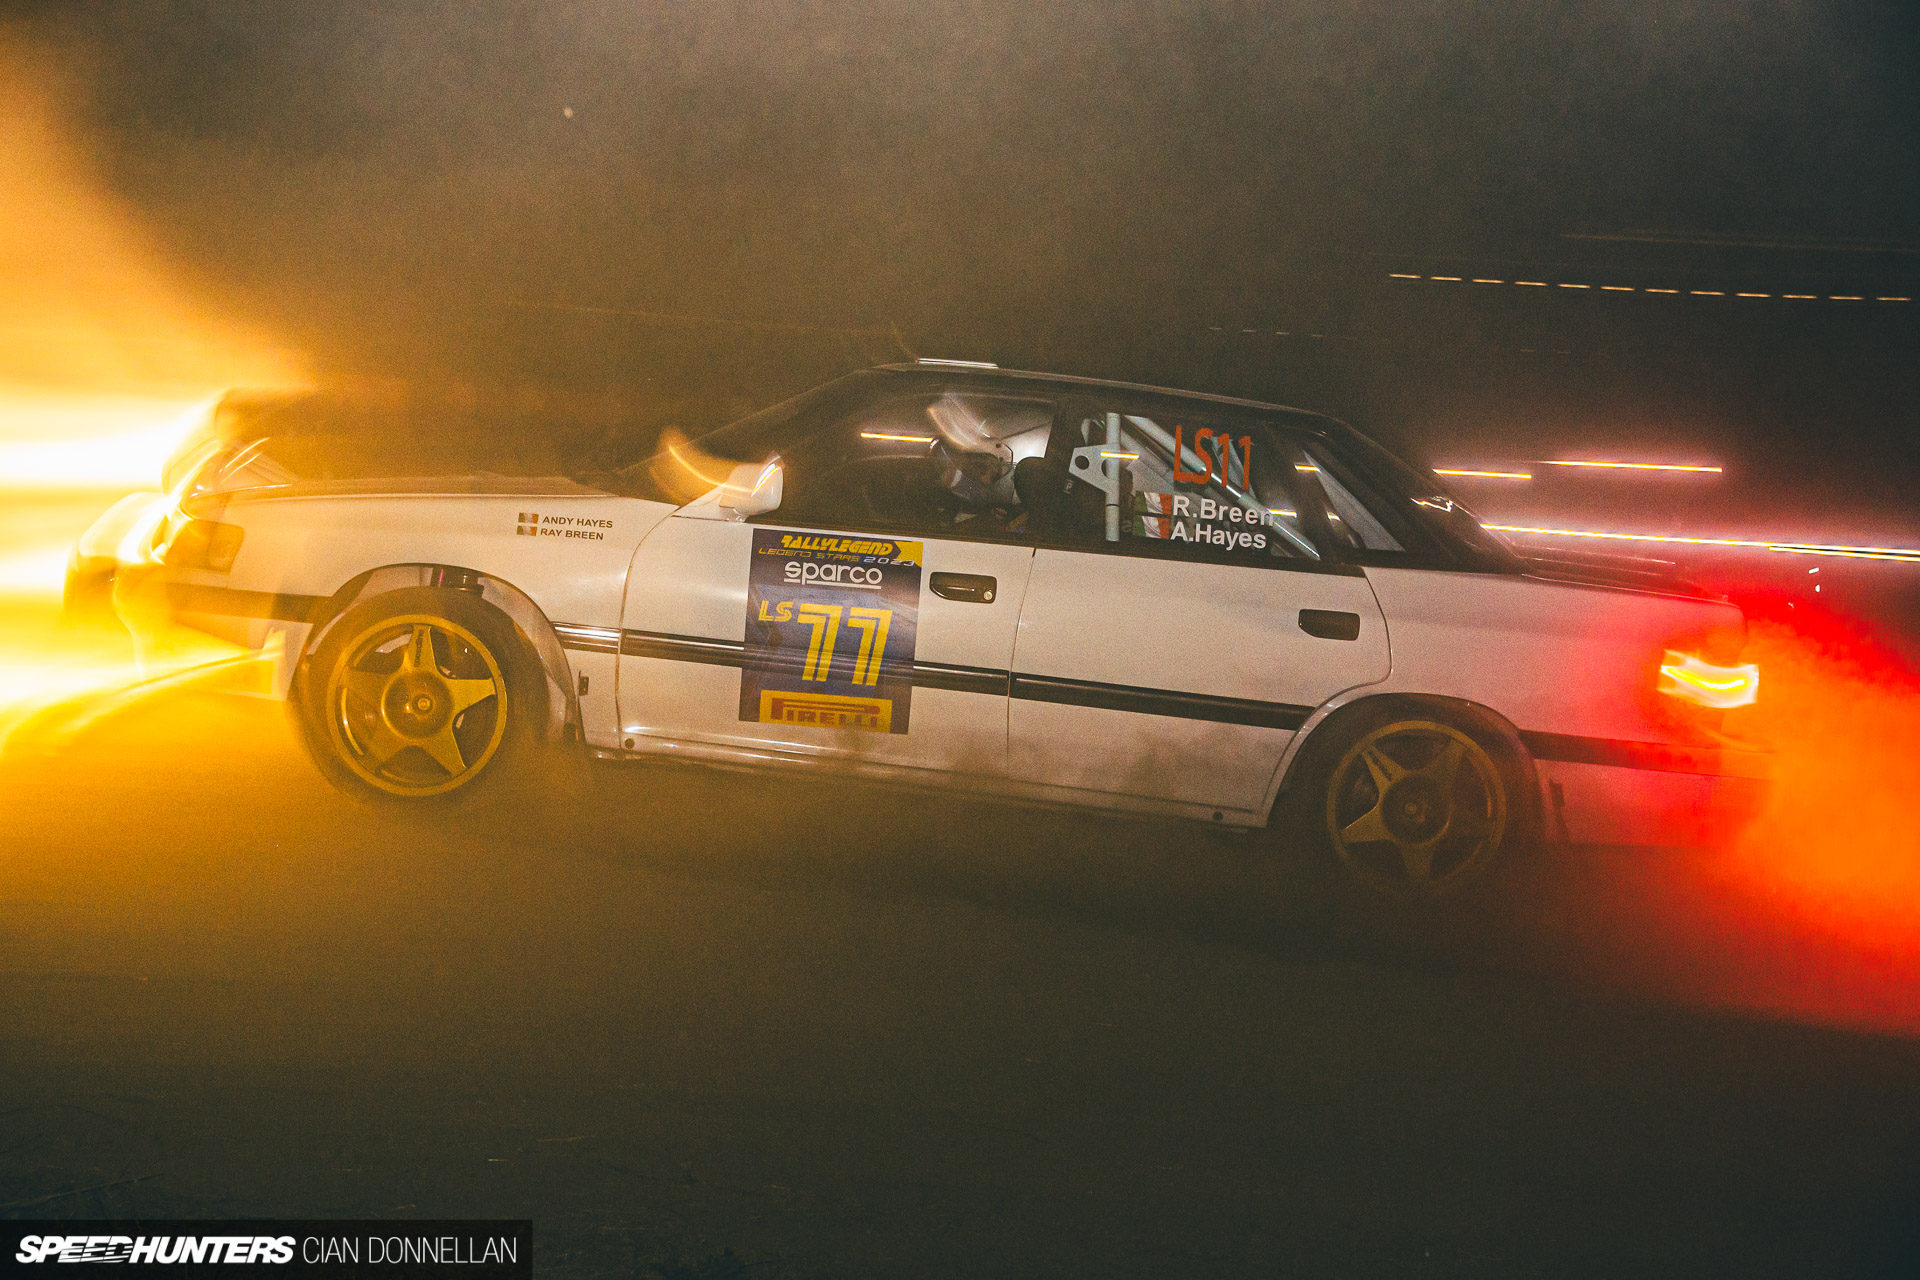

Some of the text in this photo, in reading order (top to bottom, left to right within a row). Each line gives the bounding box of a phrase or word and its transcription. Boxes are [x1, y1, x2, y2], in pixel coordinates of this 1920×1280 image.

[1173, 425, 1251, 492] LS11
[542, 516, 613, 528] ANDY HAYES
[1173, 495, 1275, 527] R.Breen
[540, 528, 604, 540] RAY BREEN
[781, 535, 894, 556] RALLYLEGEND
[1170, 521, 1267, 551] A.Hayes
[758, 547, 812, 558] LEGEND
[816, 552, 860, 562] STARS
[784, 561, 883, 590] sparco
[758, 600, 793, 622] LS
[770, 697, 881, 729] PIRELLI
